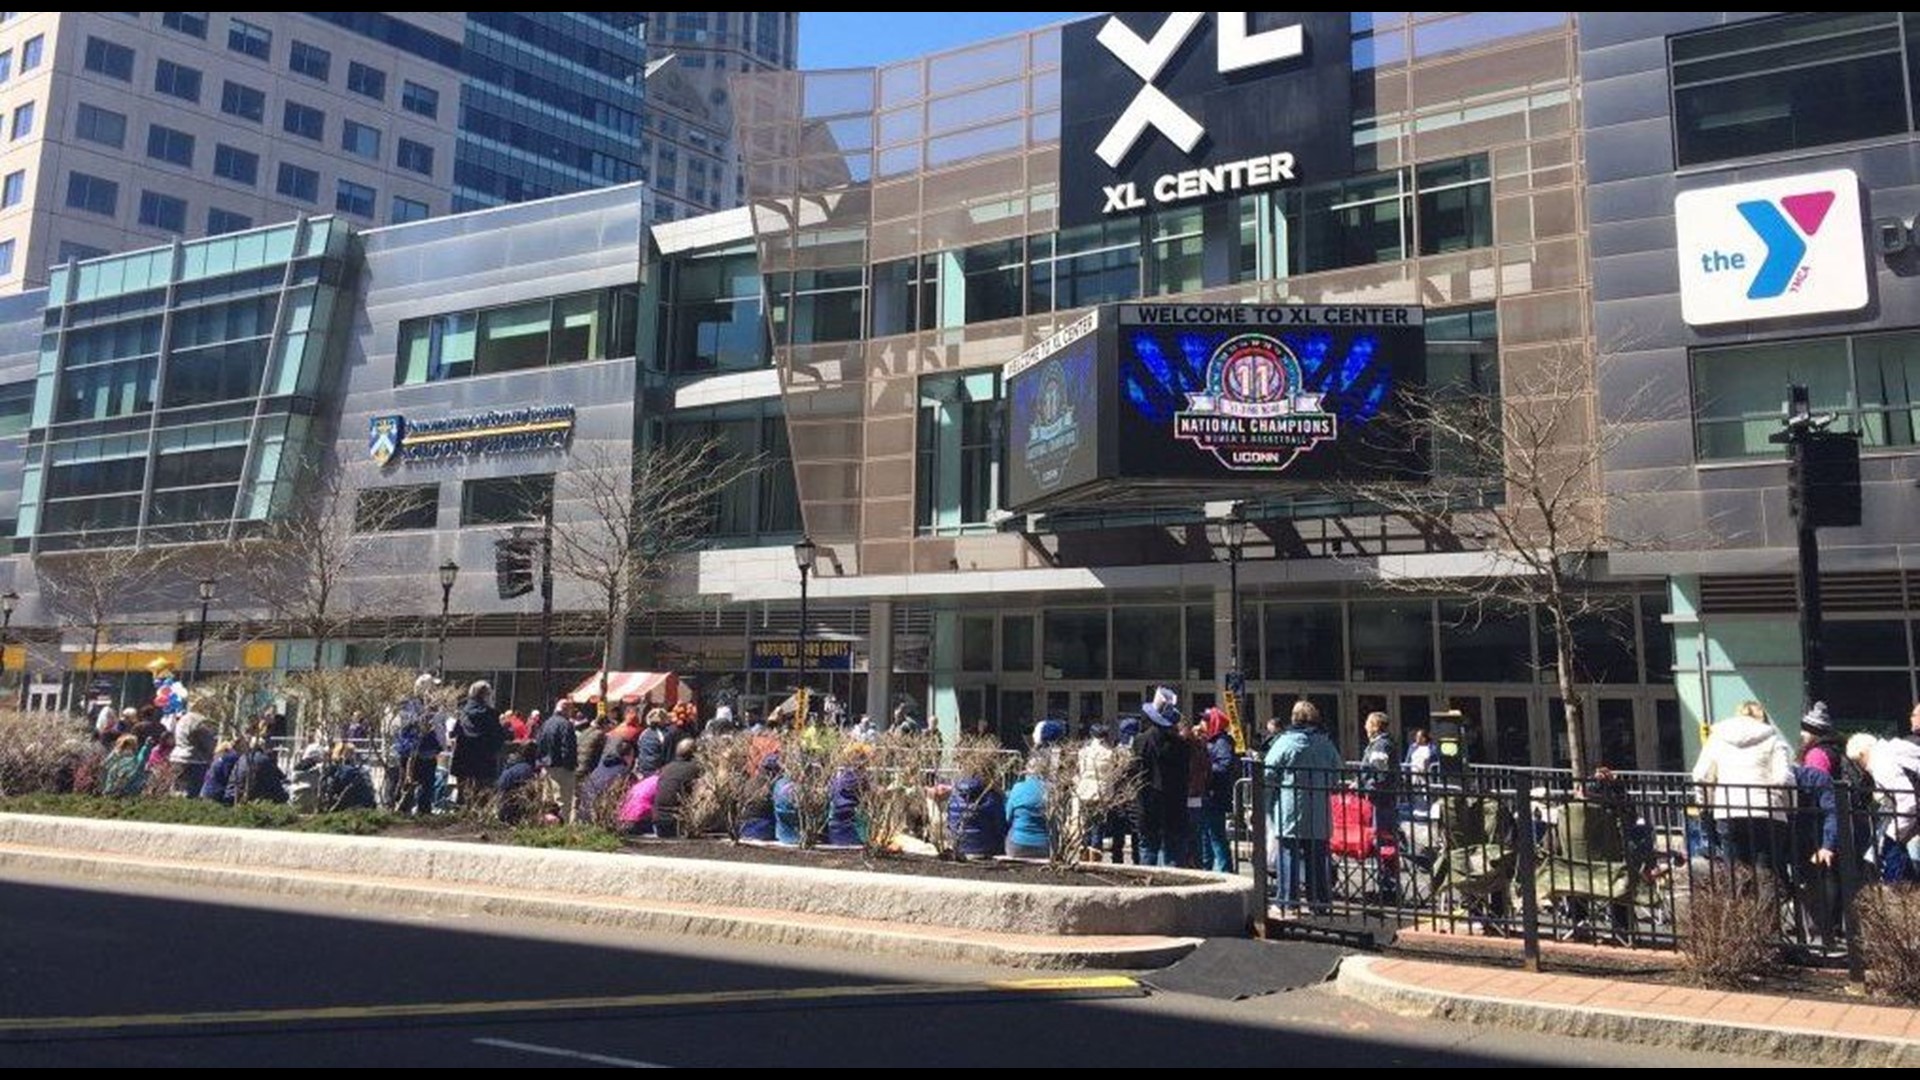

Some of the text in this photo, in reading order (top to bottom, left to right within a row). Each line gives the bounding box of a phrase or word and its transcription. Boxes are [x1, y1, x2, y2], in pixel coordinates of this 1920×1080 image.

[1102, 152, 1295, 213] XL CENTER
[1701, 251, 1746, 273] the
[1790, 266, 1810, 293] YMCA
[1139, 307, 1409, 324] WELCOME TO XL CENTER
[1237, 364, 1269, 397] 11
[1181, 418, 1330, 433] NATIONAL CHAMPIONS
[1232, 452, 1280, 463] UCONN
